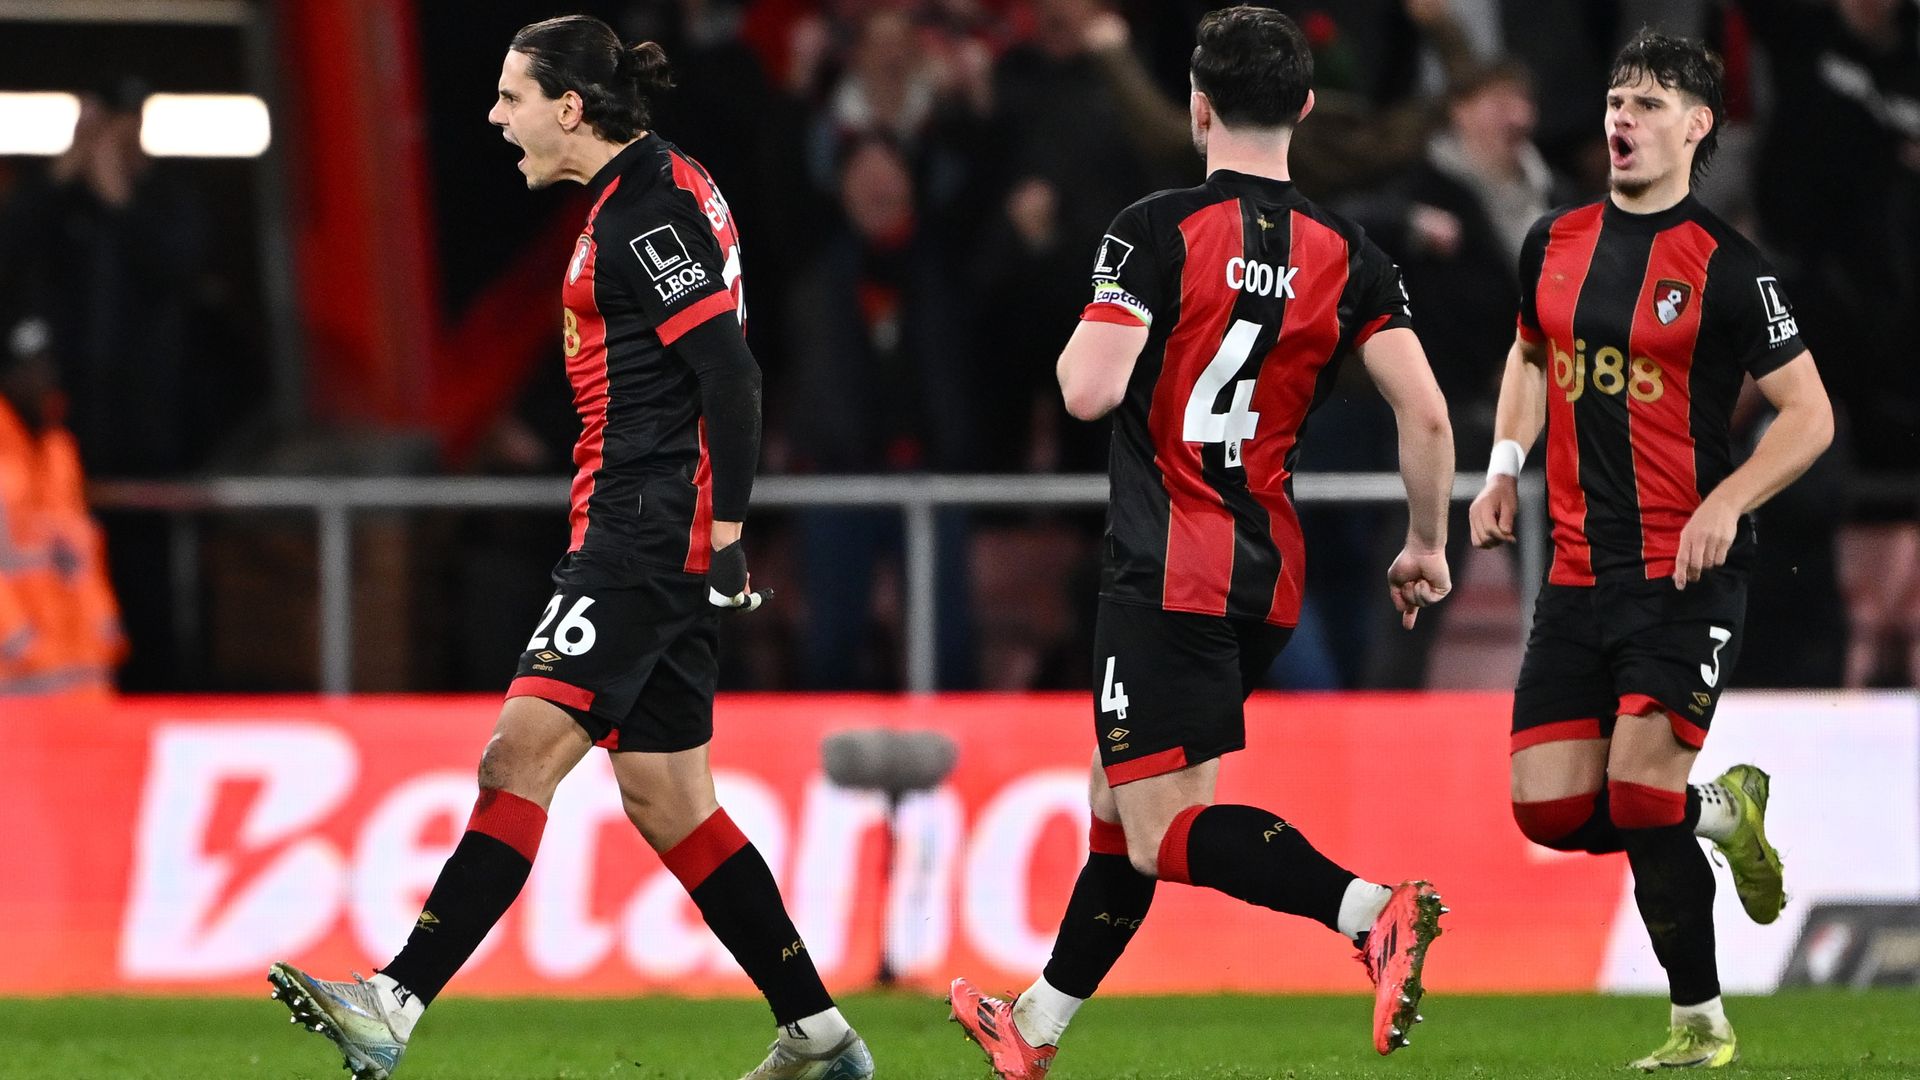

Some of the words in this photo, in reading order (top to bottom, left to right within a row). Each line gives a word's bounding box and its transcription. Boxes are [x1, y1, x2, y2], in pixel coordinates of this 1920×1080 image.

[655, 262, 706, 301] LEOS
[1097, 290, 1151, 316] Captain
[1226, 256, 1299, 299] COOK
[563, 307, 581, 358] 8
[1183, 318, 1260, 468] 4
[1551, 338, 1665, 403] bj88
[526, 594, 597, 656] 26
[1101, 656, 1129, 720] 4
[1700, 626, 1732, 688] 3
[116, 721, 1098, 981] Betano
